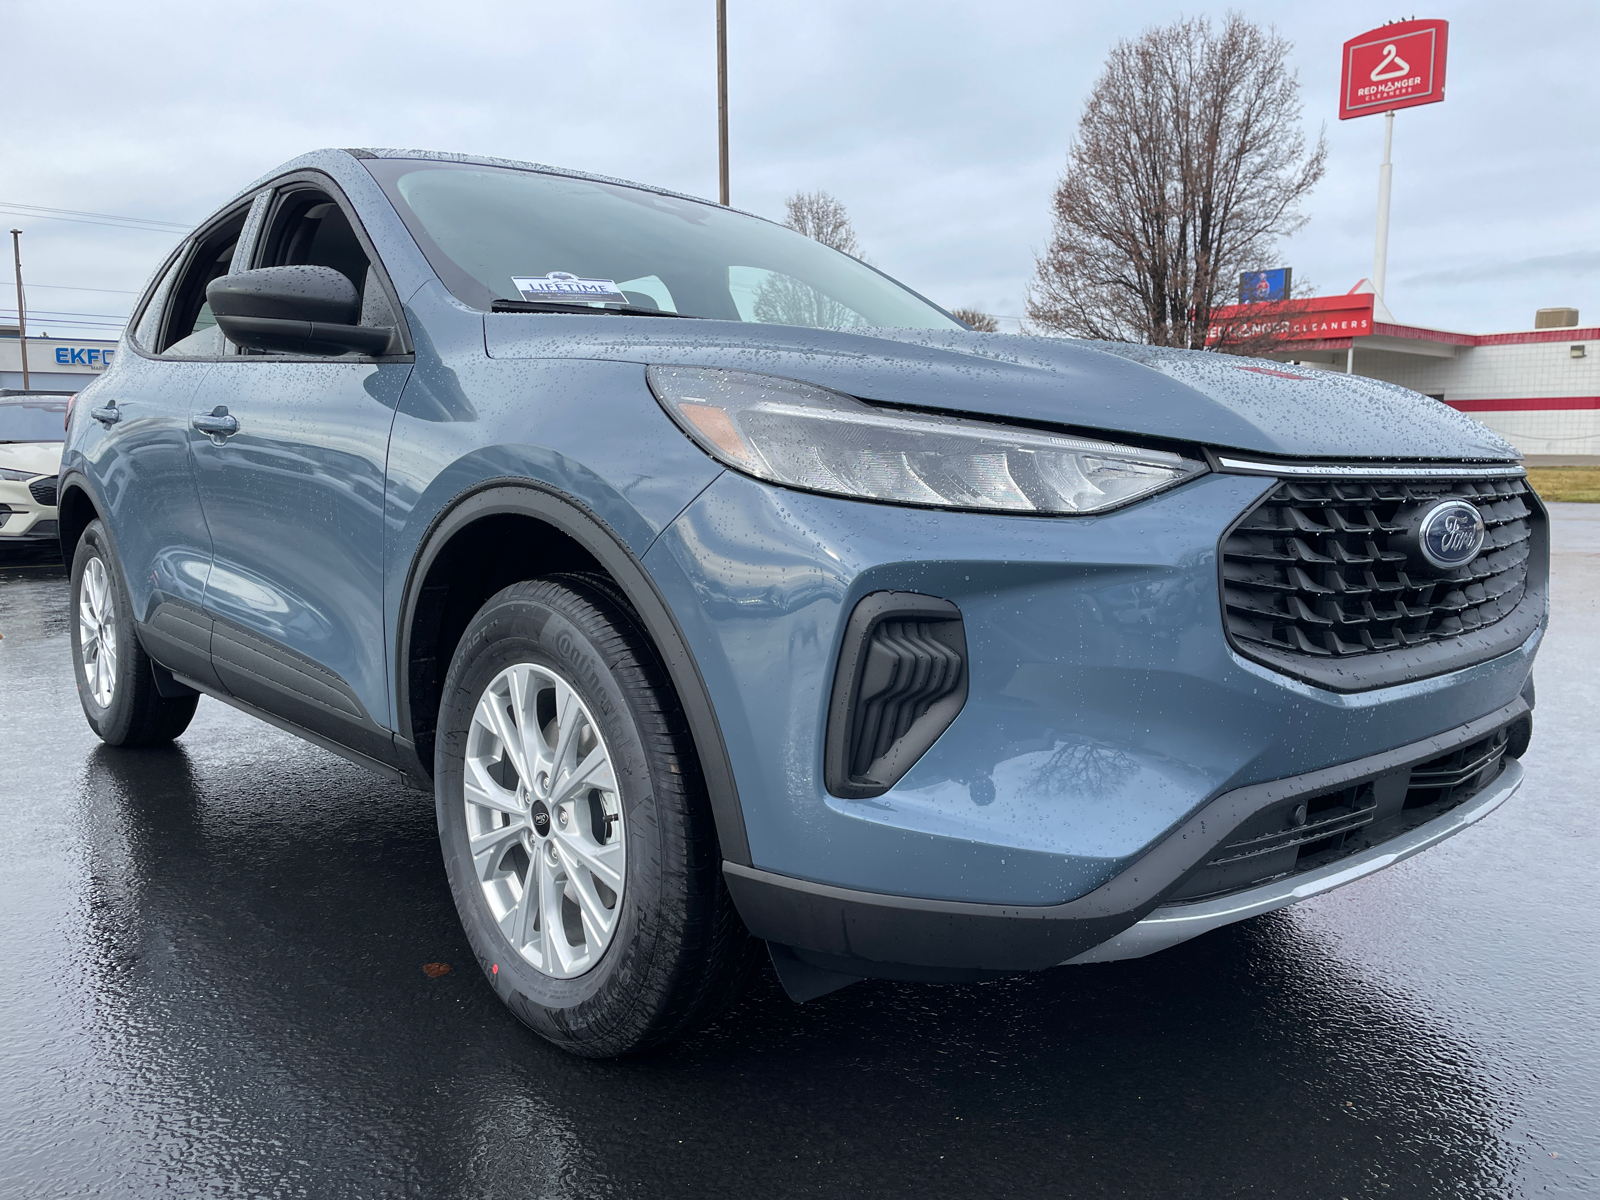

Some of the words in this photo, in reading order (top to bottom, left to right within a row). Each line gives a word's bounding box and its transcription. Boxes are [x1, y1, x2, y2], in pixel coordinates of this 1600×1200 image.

[1358, 86, 1377, 97] RED
[1365, 87, 1412, 101] CLEANERS
[529, 283, 610, 294] LIFETIME
[1294, 319, 1367, 332] CLEANERS
[1441, 515, 1477, 553] Ford
[555, 628, 633, 750] Continental
